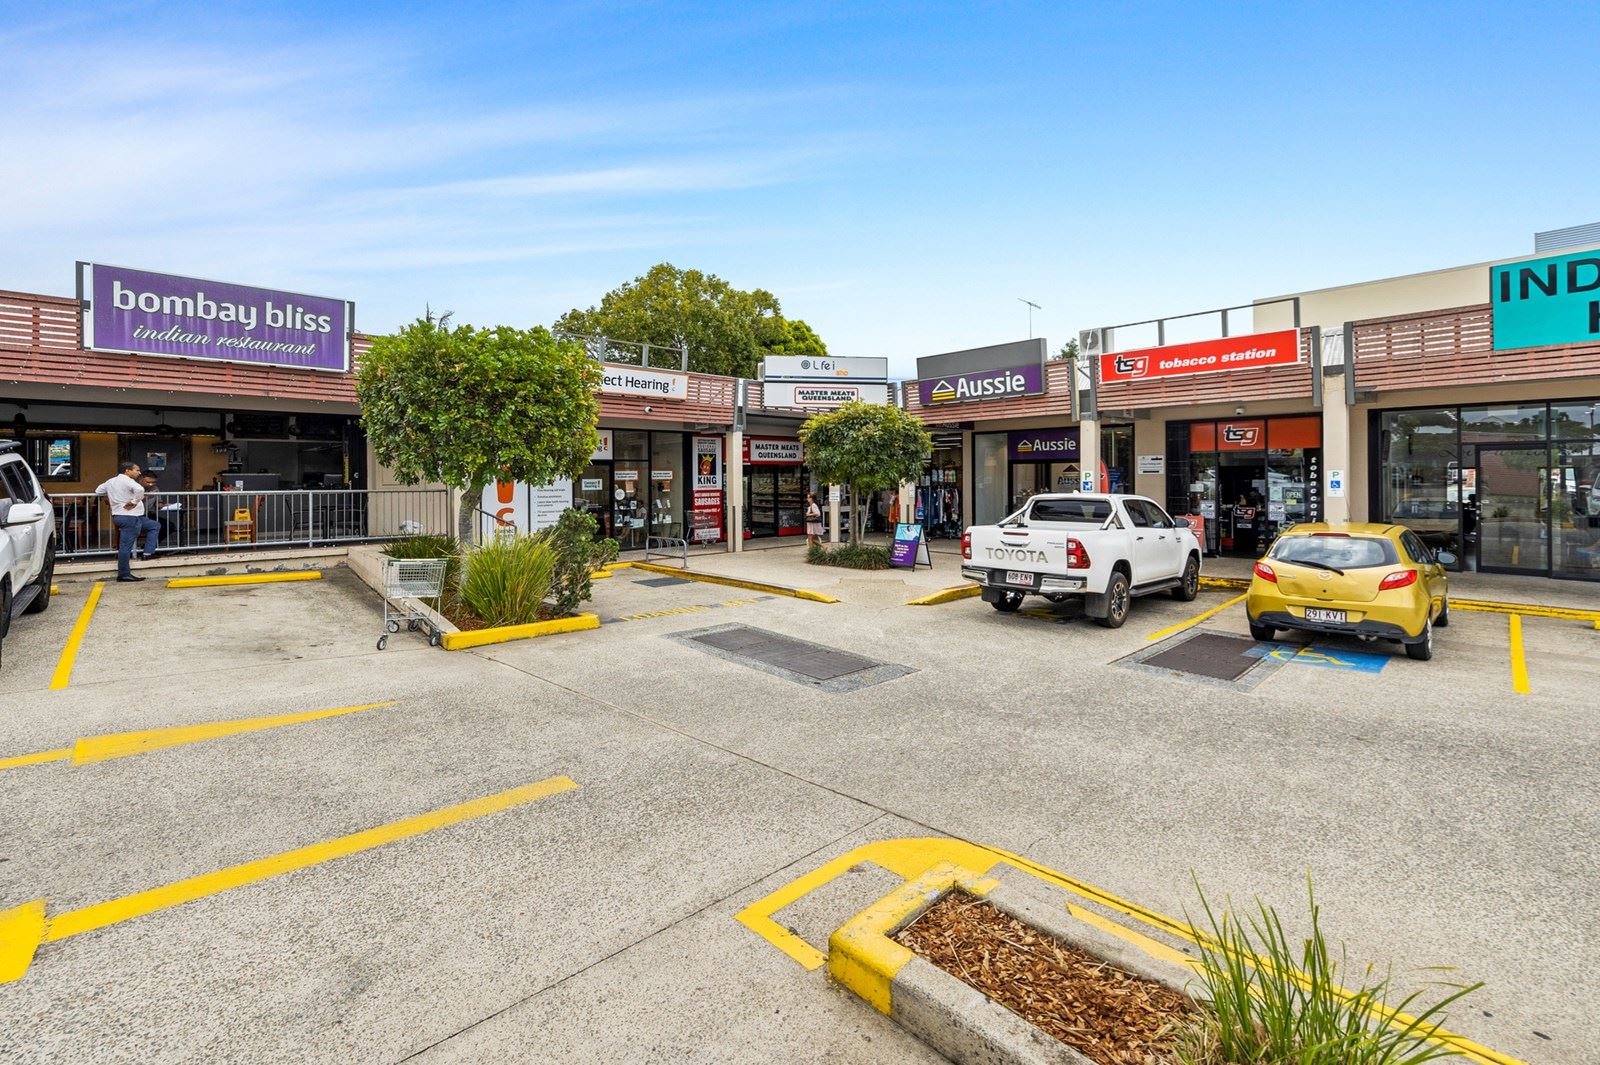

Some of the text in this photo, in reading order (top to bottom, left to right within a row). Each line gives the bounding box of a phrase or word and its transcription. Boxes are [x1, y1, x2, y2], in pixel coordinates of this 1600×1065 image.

[113, 281, 331, 333] bombay bliss
[133, 325, 316, 355] indian restaurant
[1115, 348, 1276, 377] tsg tobacco station
[625, 376, 669, 393] Hearing
[957, 371, 1025, 398] Aussie
[1224, 424, 1259, 446] tsg
[1033, 438, 1076, 451] Aussie
[698, 476, 717, 485] KING
[1058, 475, 1080, 485] Auss
[1085, 472, 1091, 480] P
[985, 547, 1048, 563] TOYOTA
[1306, 610, 1343, 620] 291 KVI
